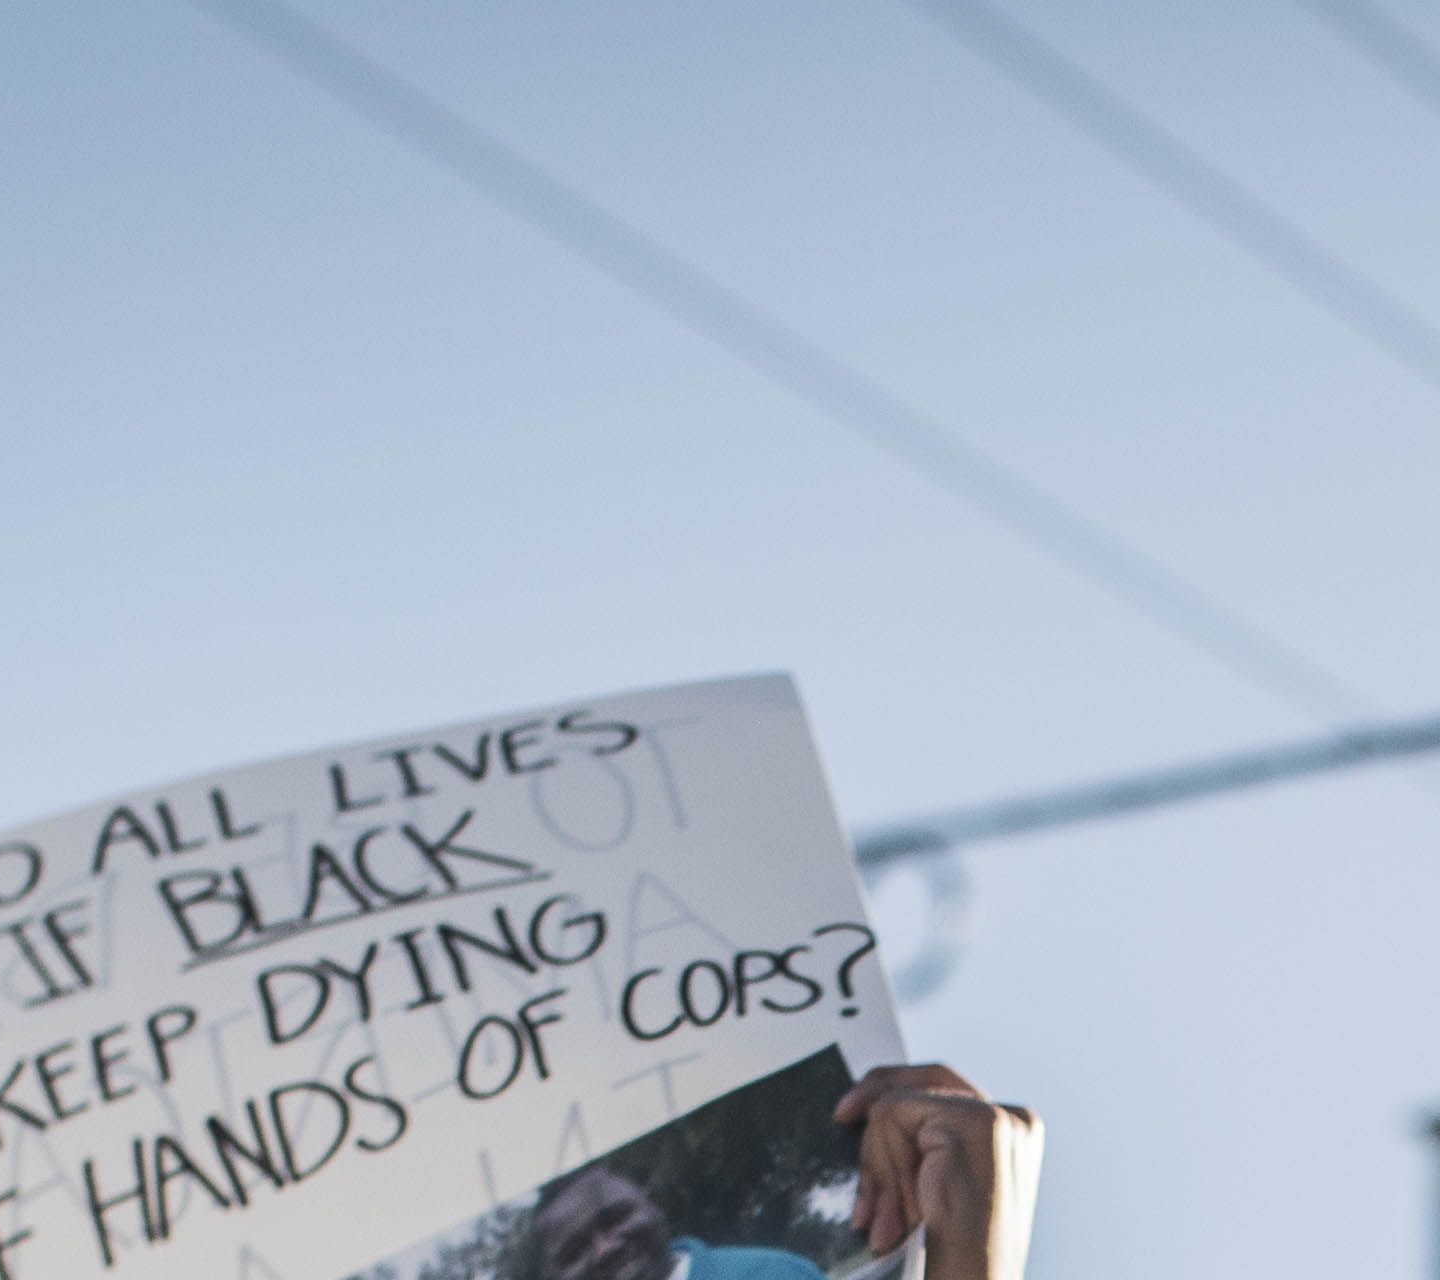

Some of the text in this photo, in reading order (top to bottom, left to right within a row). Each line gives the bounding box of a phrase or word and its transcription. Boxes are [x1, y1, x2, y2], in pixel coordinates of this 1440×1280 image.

[91, 788, 264, 876] ALL
[328, 709, 639, 813] LIVES
[157, 809, 535, 961] BLACK
[257, 892, 607, 1045] DYING
[82, 1054, 410, 1270] HANDS
[458, 986, 569, 1102] OF
[620, 921, 877, 1042] COPS?
